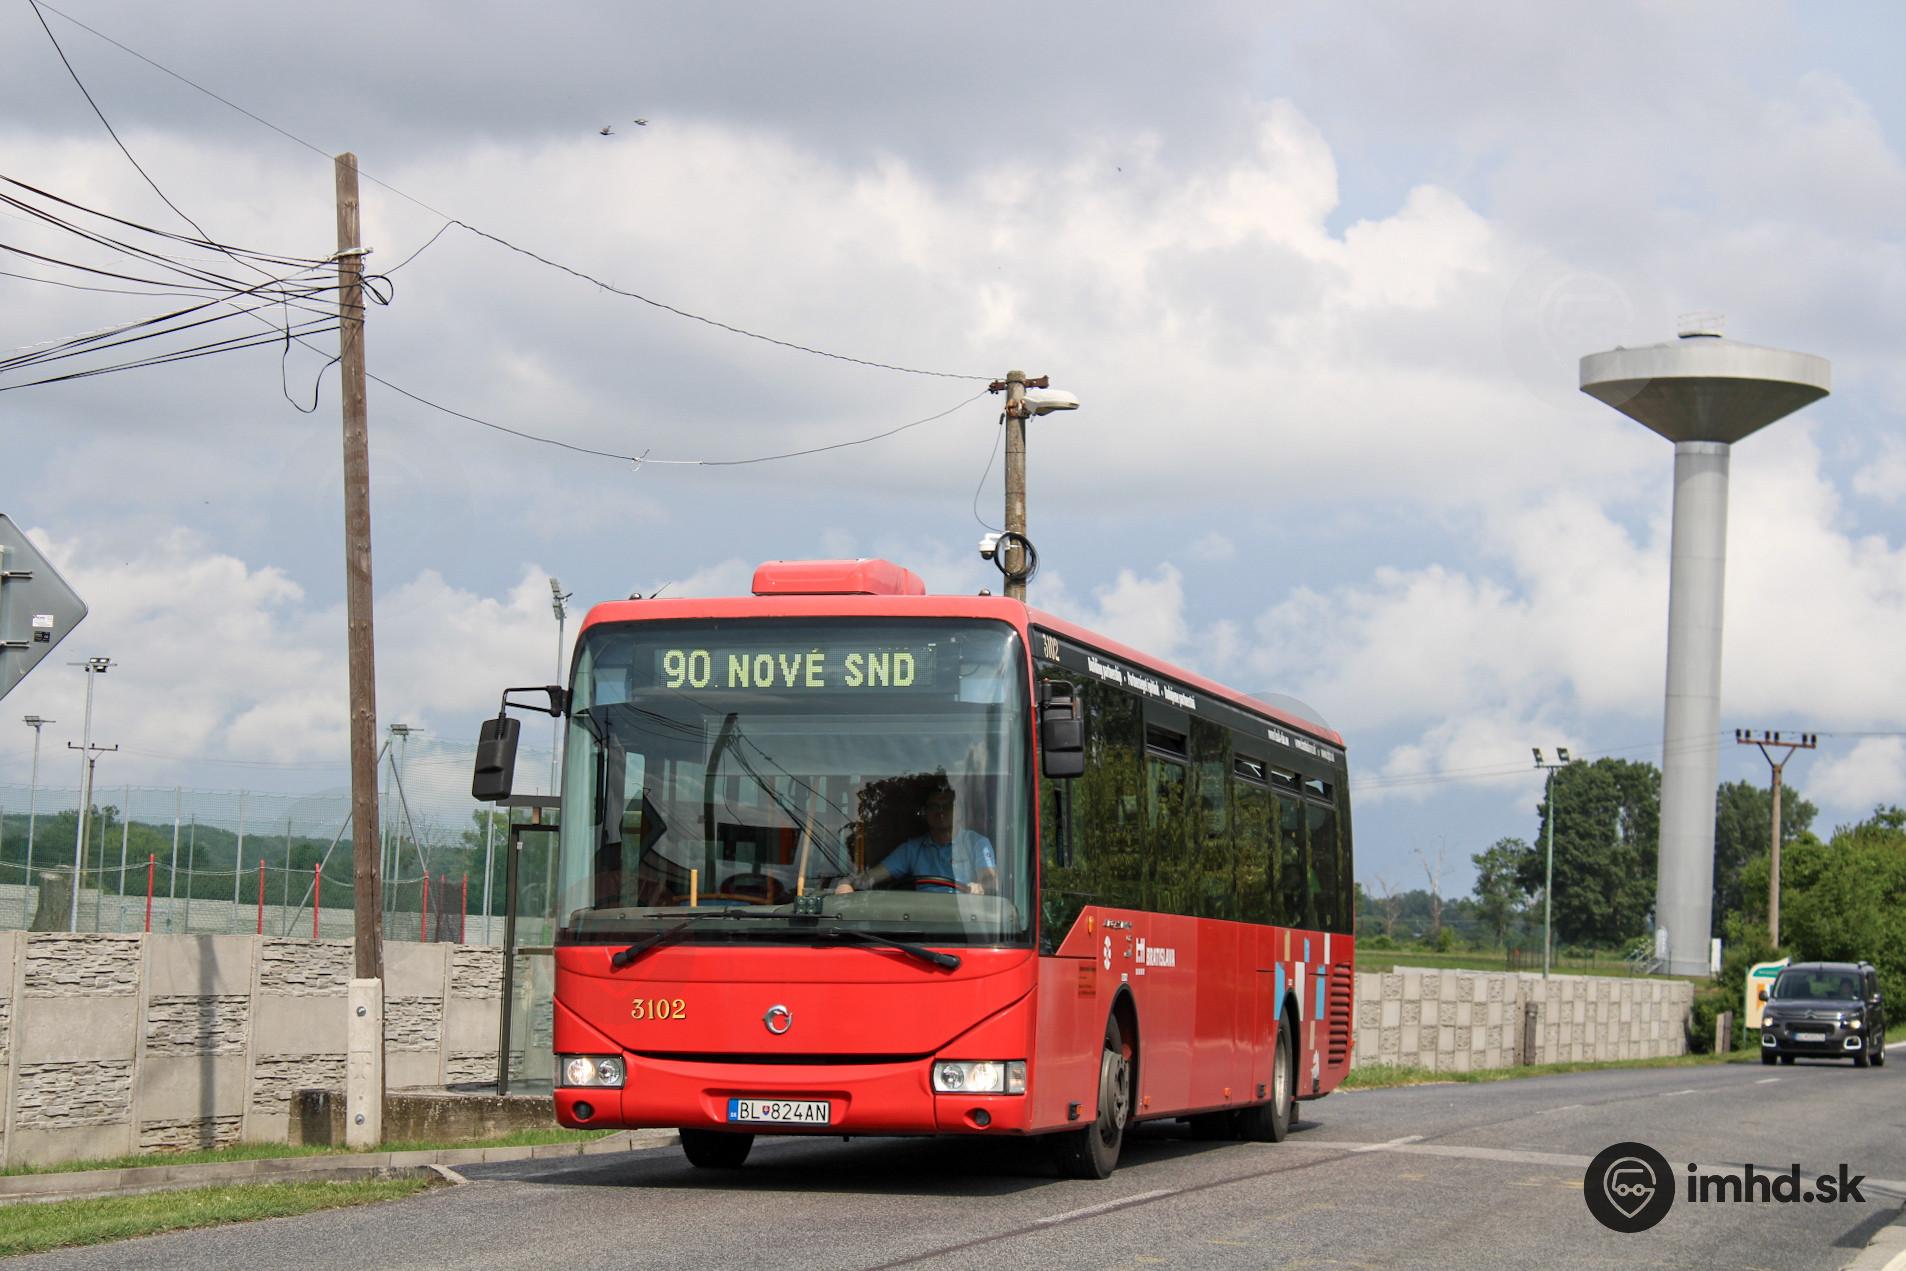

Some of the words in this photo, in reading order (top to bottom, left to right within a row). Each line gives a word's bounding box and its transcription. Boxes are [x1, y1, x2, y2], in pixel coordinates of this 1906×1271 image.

[1042, 633, 1060, 662] 3102
[728, 648, 825, 688] NOVÉ
[845, 652, 915, 687] SND
[631, 997, 687, 1021] 3102
